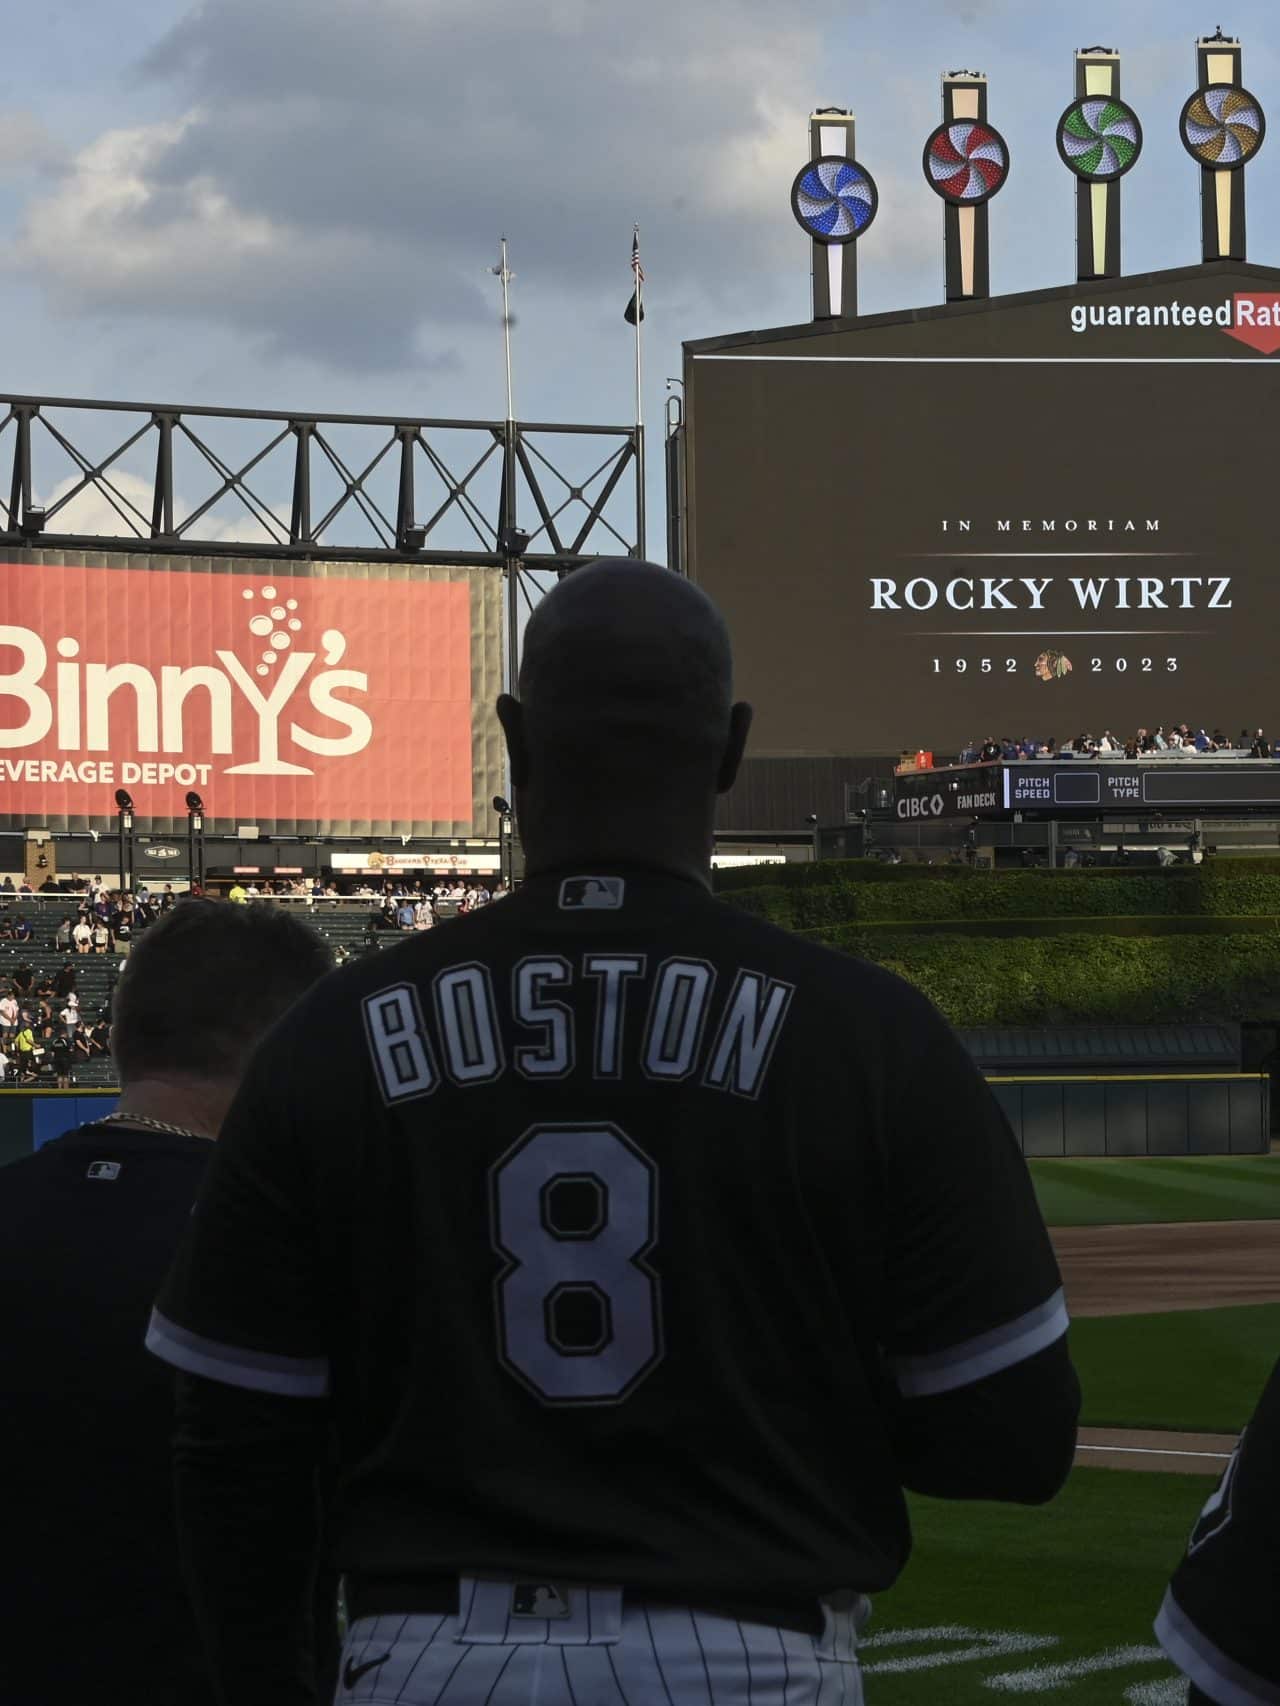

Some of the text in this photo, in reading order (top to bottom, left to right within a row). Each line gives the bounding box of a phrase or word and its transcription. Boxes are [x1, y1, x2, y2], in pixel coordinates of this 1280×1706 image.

[1070, 299, 1231, 333] guaranteed
[942, 519, 1160, 532] IN MEMORIAM
[869, 577, 1232, 610] ROCKY WIRTZ
[933, 657, 1178, 673] 1952 2023
[121, 762, 213, 786] DEPOT
[1018, 777, 1050, 788] PITCH
[1107, 776, 1140, 787] PITCH
[957, 792, 996, 809] FAN DECK
[1015, 788, 1050, 799] SPEED
[1112, 787, 1140, 798] TYPE
[897, 797, 929, 818] CIBC
[361, 952, 797, 1107] BOSTON
[488, 1121, 664, 1408] 8
